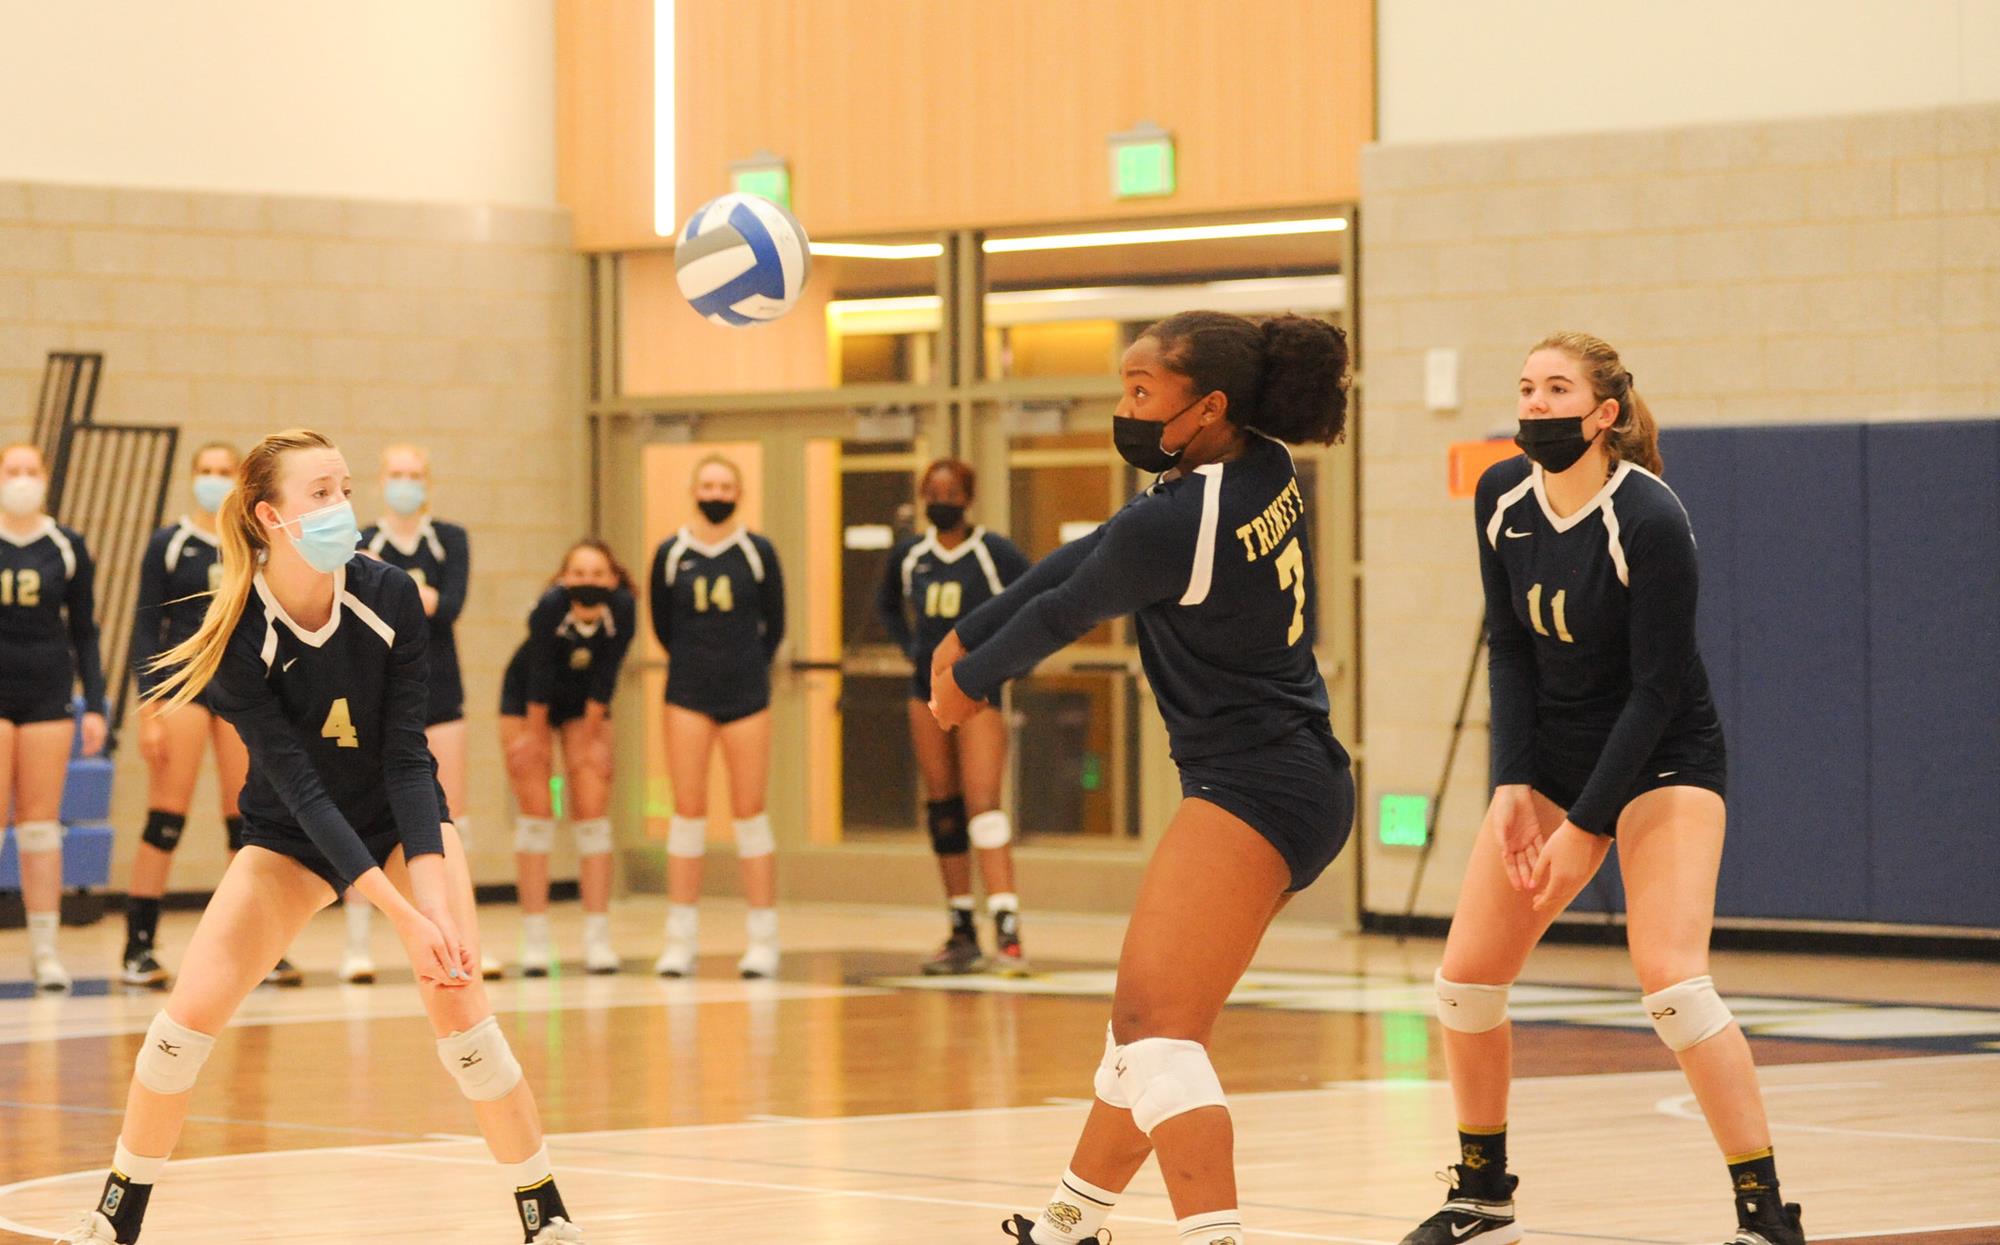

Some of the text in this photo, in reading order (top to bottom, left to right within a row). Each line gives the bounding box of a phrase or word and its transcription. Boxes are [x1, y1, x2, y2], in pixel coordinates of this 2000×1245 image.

[1235, 476, 1304, 562] TRINITY
[0, 568, 41, 606] 12
[693, 574, 733, 612] 14
[926, 581, 962, 618] 10
[1275, 536, 1305, 647] 7
[1527, 583, 1573, 643] 11
[321, 698, 359, 748] 4
